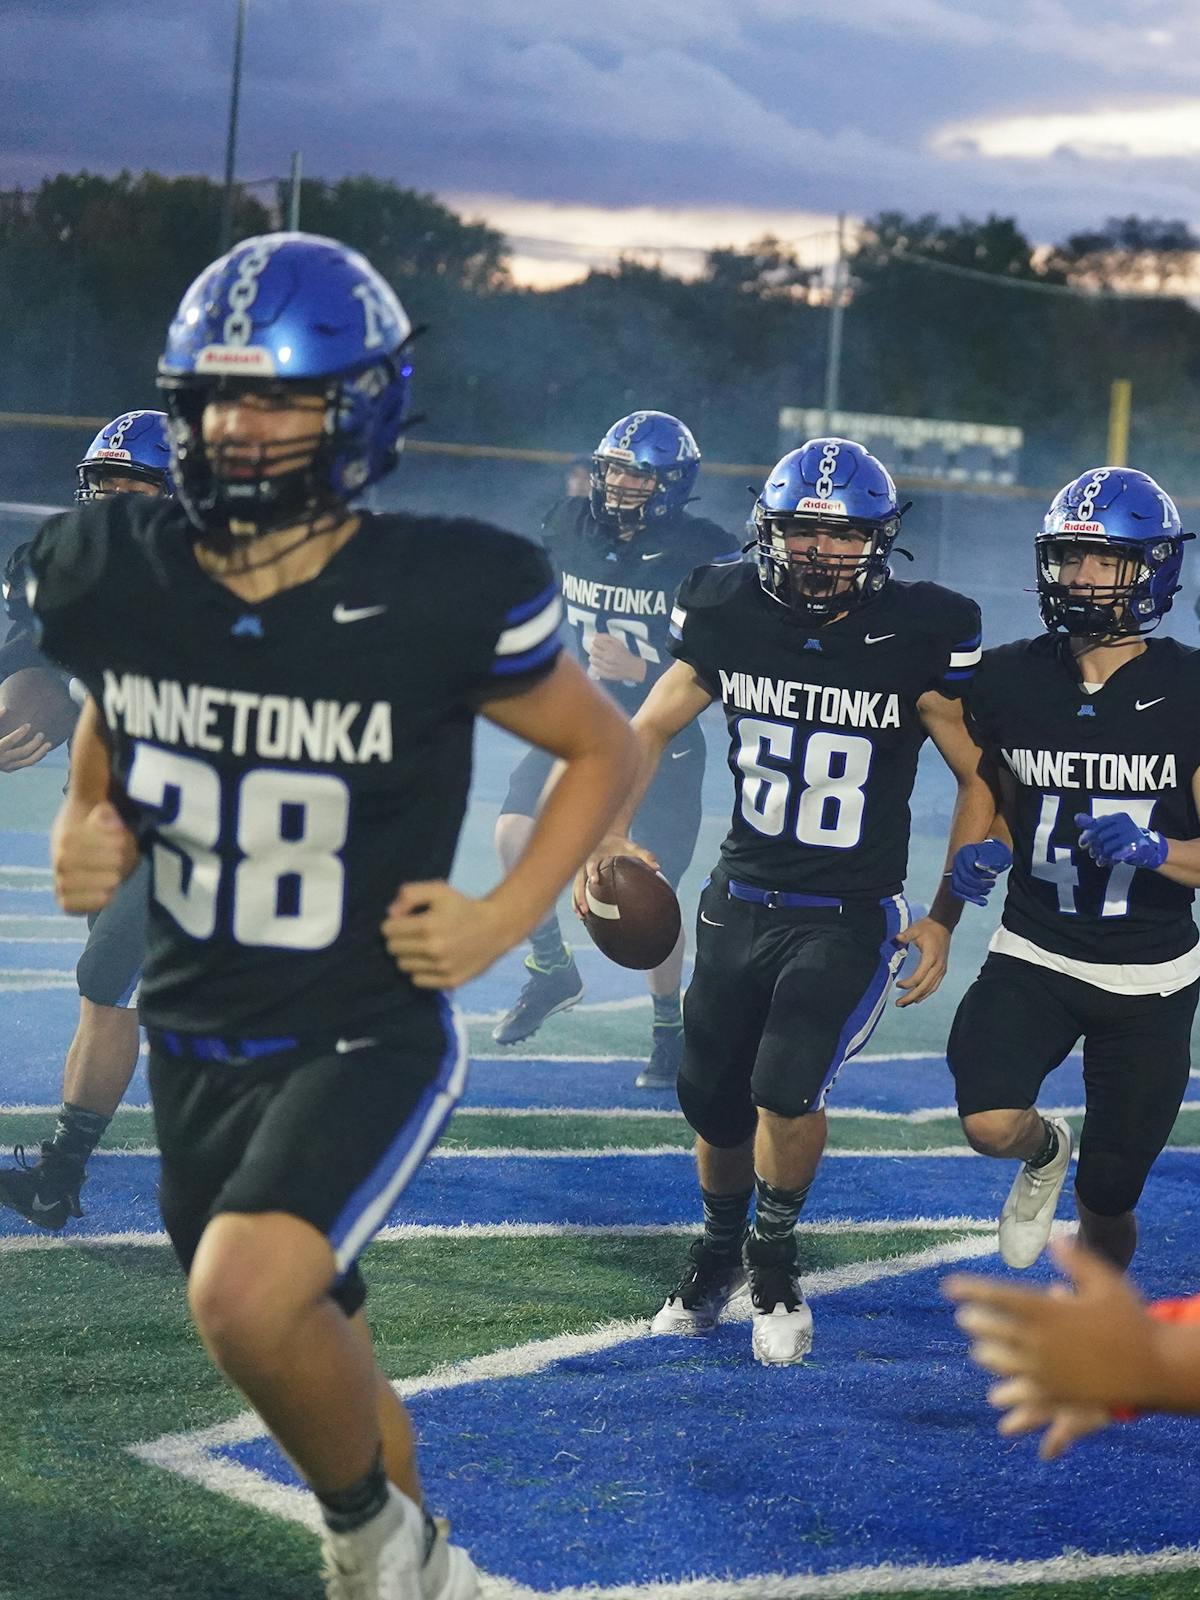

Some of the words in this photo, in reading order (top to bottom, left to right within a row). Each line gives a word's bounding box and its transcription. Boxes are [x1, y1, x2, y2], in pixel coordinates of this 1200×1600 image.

[1064, 523, 1099, 531] Riddell
[562, 570, 667, 615] MINNETONKA
[103, 669, 394, 764] MINNETONKA
[718, 669, 901, 729] MINNETONKA
[736, 717, 873, 850] 68
[1001, 748, 1178, 791] MINNETONKA
[126, 740, 350, 951] 38
[1031, 794, 1159, 918] 47
